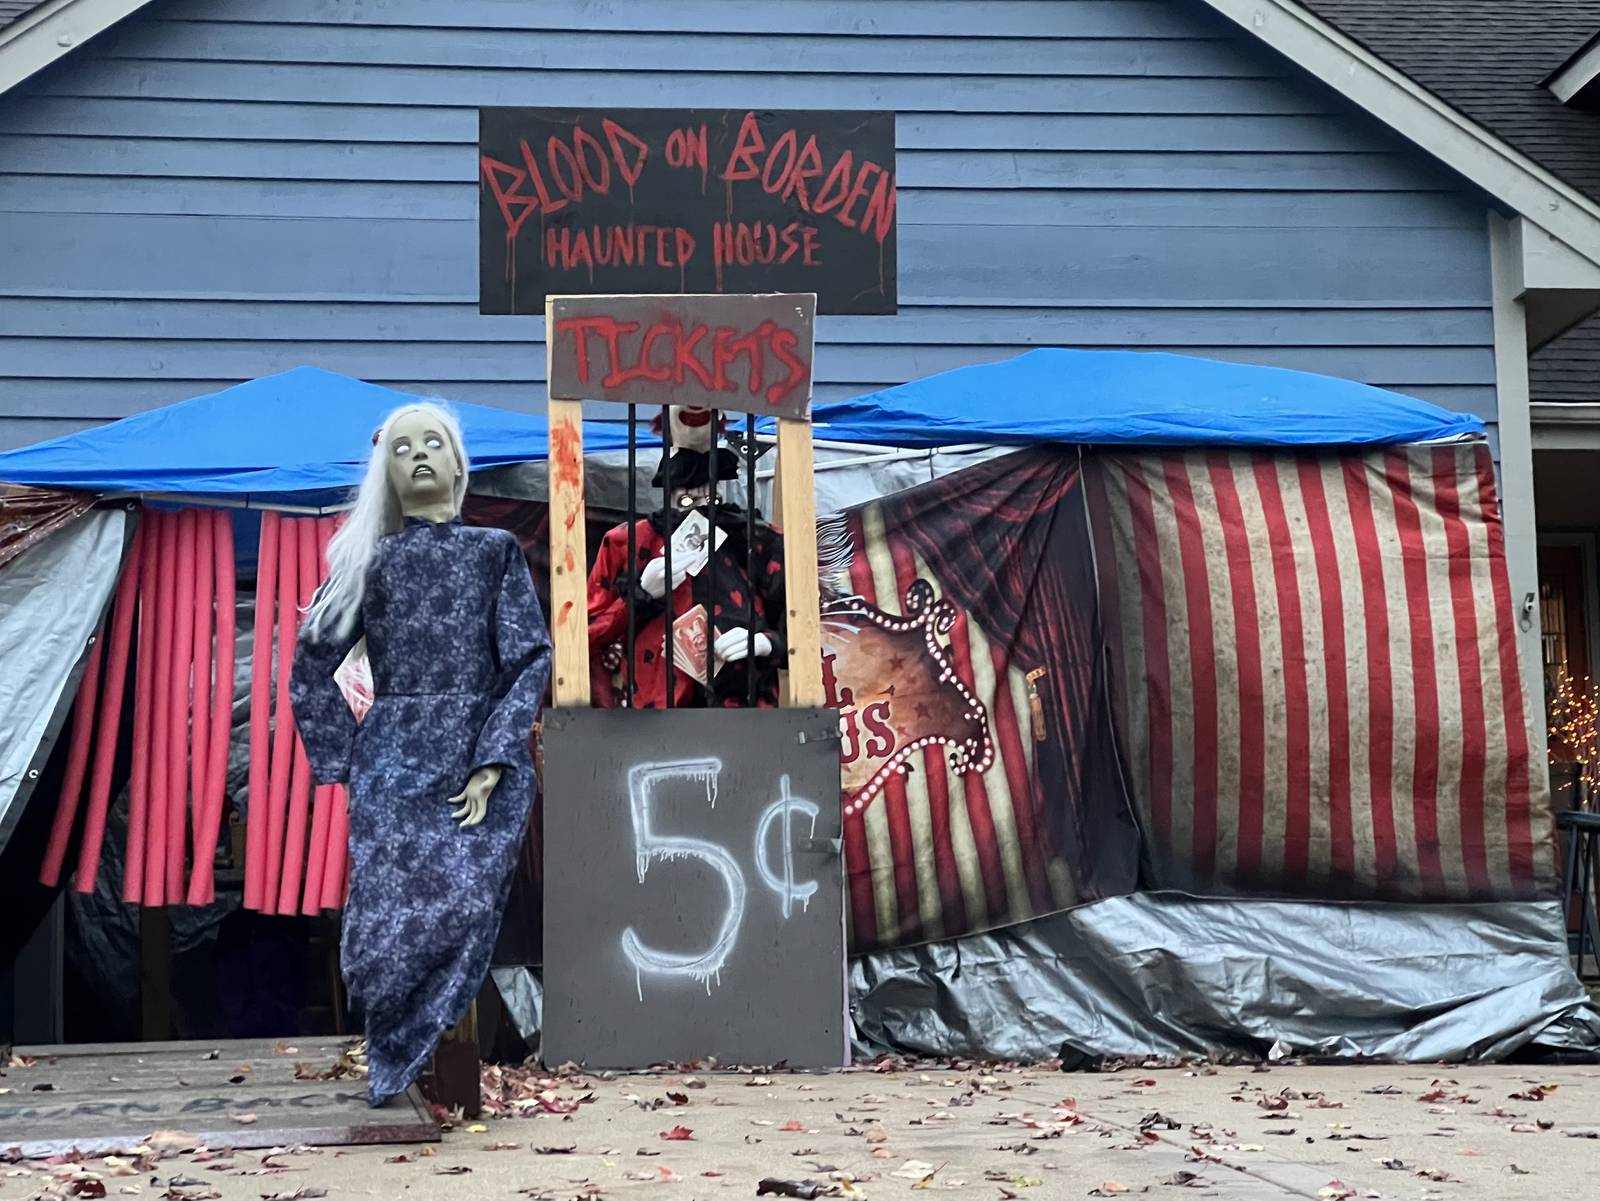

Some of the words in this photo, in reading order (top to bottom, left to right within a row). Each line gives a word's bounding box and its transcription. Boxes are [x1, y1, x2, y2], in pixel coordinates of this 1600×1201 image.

[480, 117, 649, 238] BLOOD
[665, 122, 708, 172] ON
[721, 111, 896, 241] BORDEN
[547, 222, 696, 270] HAUNTED
[713, 221, 823, 268] HOUSE
[556, 315, 808, 404] TICKETS
